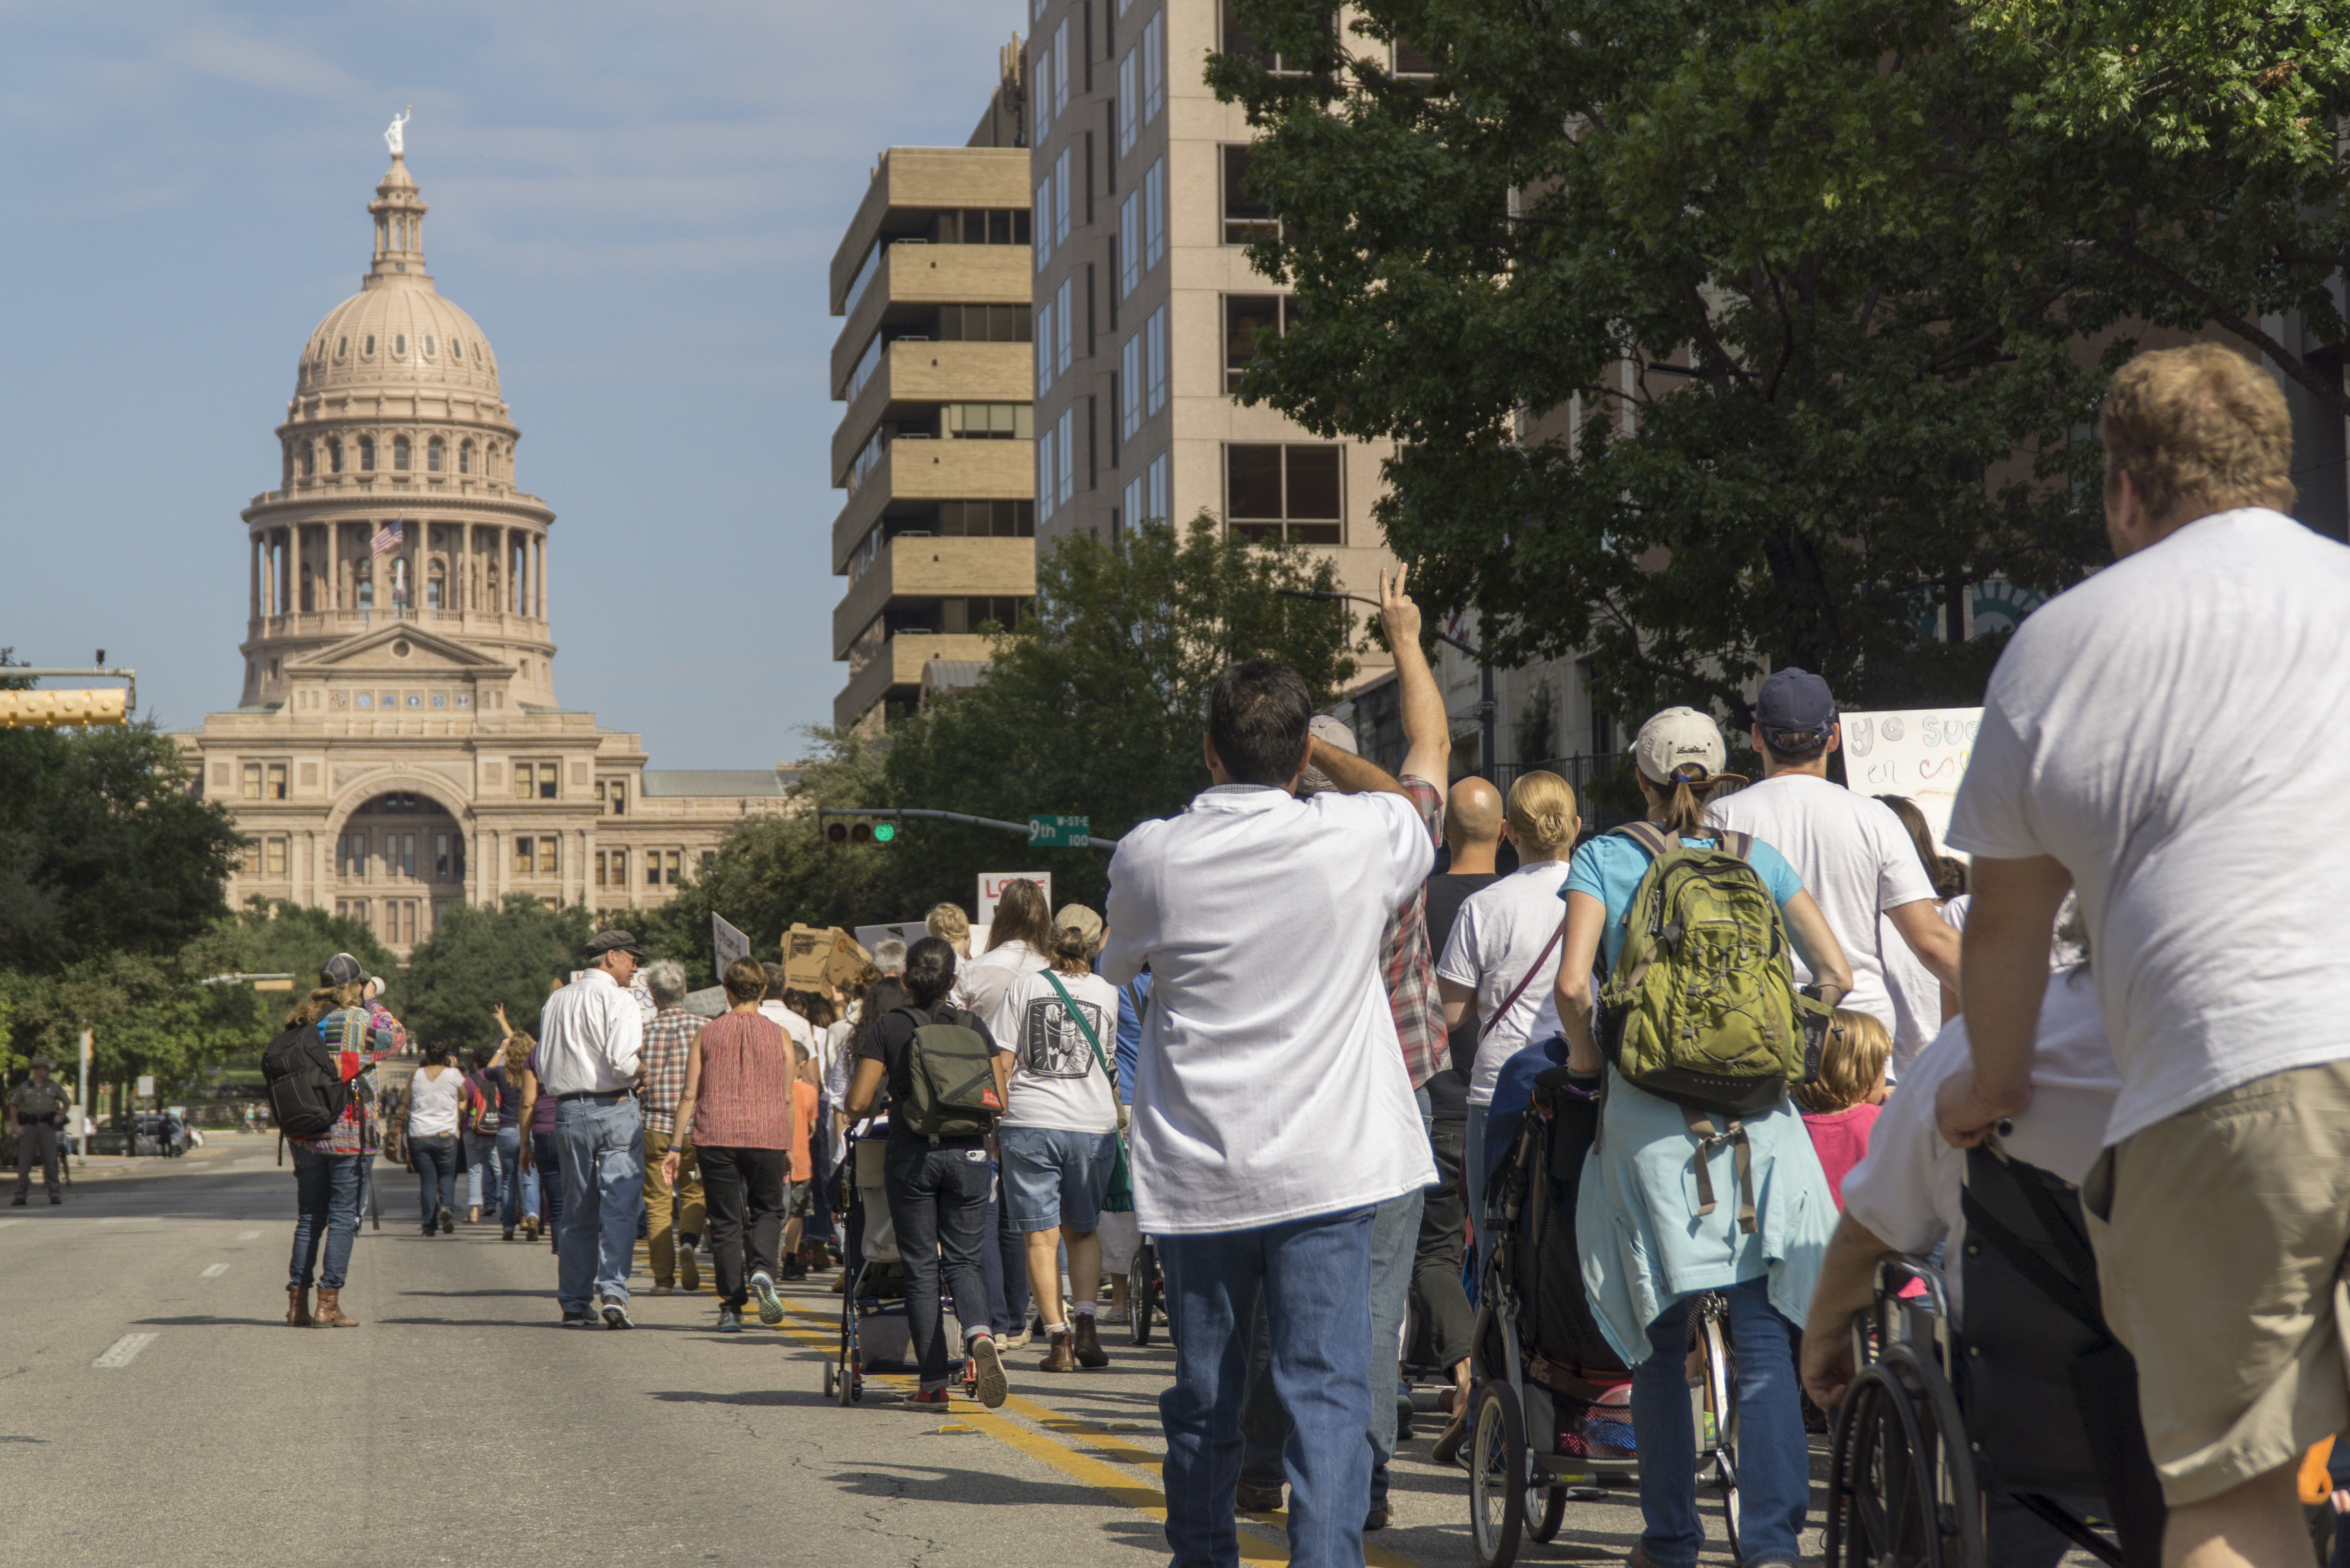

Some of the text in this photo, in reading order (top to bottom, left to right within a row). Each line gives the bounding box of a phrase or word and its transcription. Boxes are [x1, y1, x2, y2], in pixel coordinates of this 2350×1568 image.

[1851, 716, 1981, 757] yo sue
[1868, 749, 1969, 784] en col
[1029, 819, 1056, 842] 9th
[1069, 835, 1089, 846] 100
[985, 877, 1047, 898] LOE
[717, 922, 741, 956] Stand
